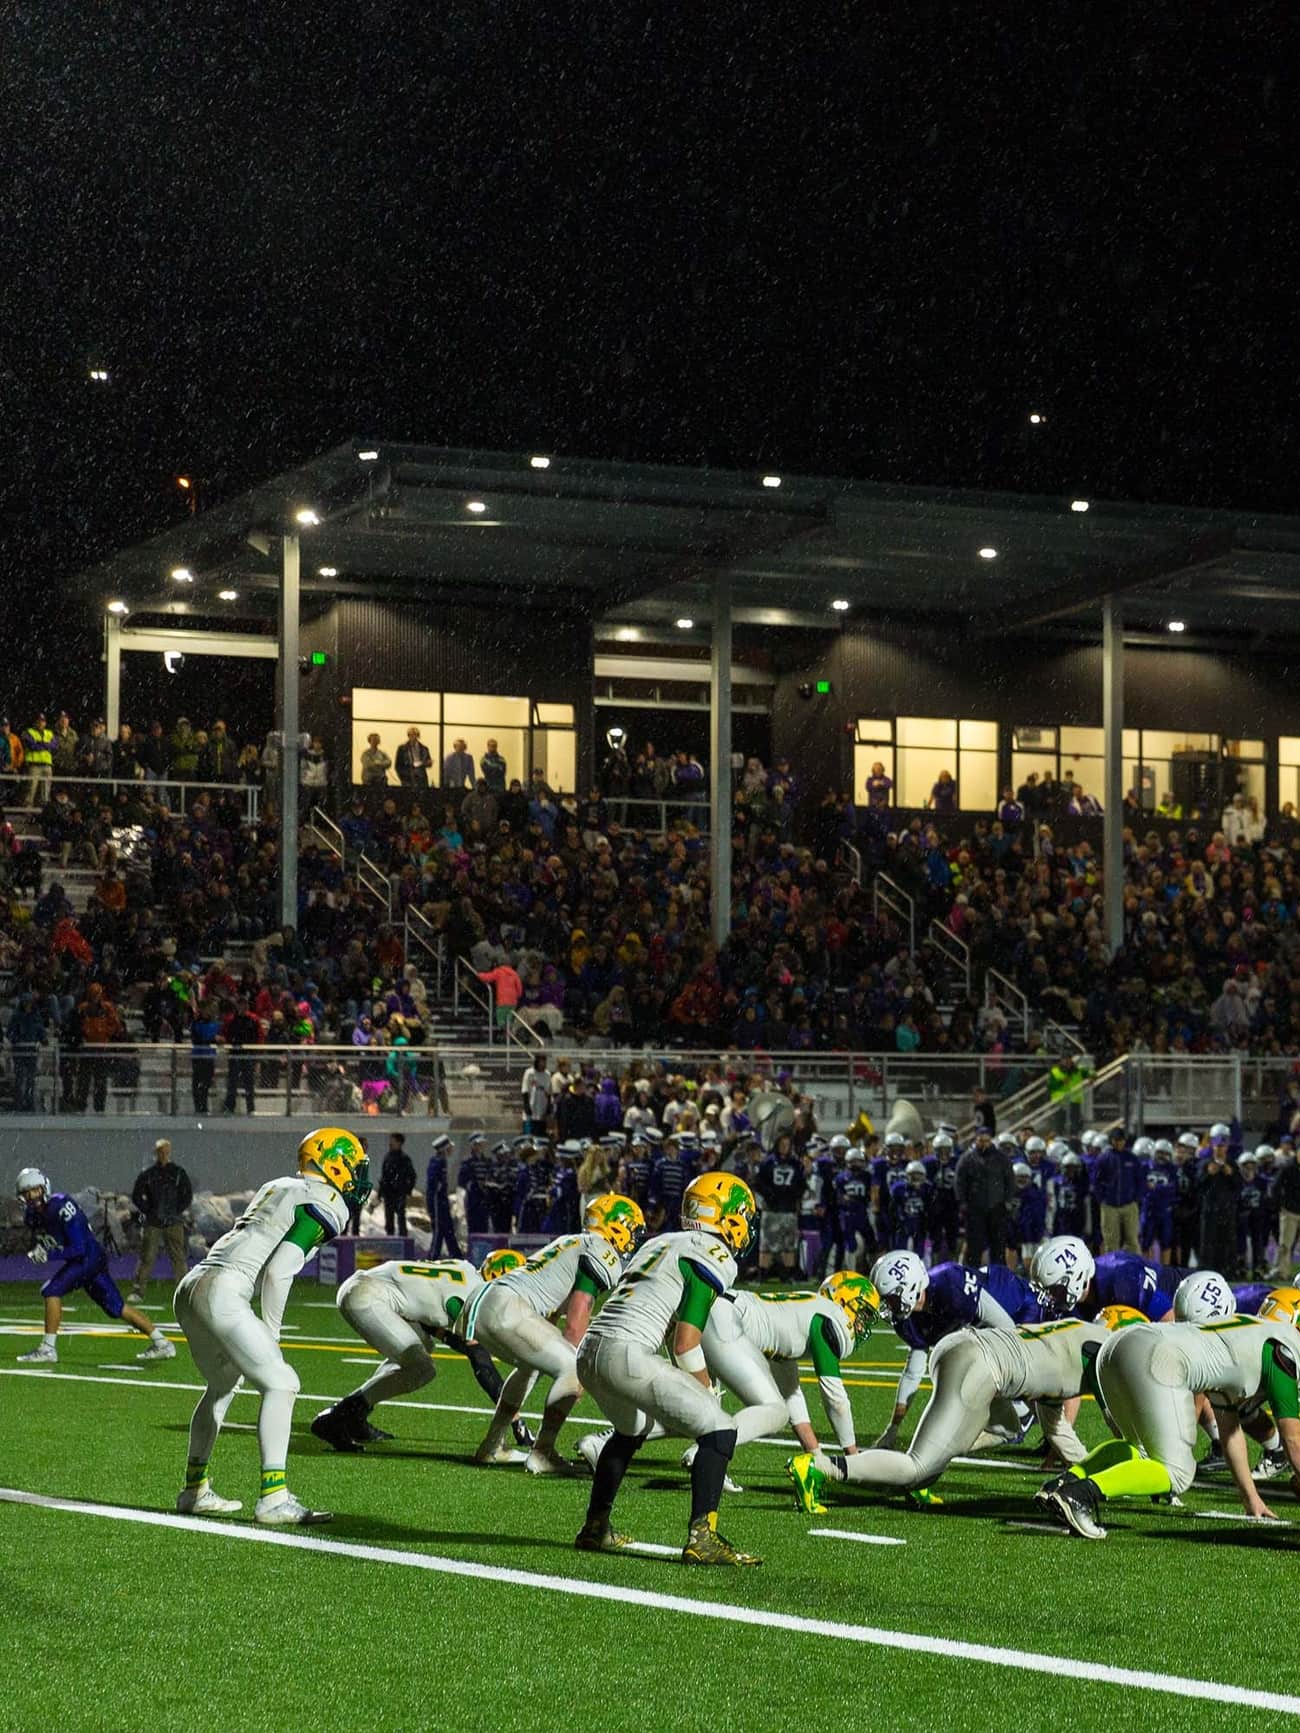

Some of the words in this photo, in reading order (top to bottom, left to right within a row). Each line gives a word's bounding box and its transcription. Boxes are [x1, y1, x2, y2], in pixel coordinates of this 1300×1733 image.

[58, 1201, 77, 1222] 38
[602, 1250, 618, 1266] 35
[709, 1244, 729, 1263] 22
[1055, 1249, 1078, 1269] 74
[888, 1260, 911, 1281] 35
[1200, 1282, 1222, 1306] 55
